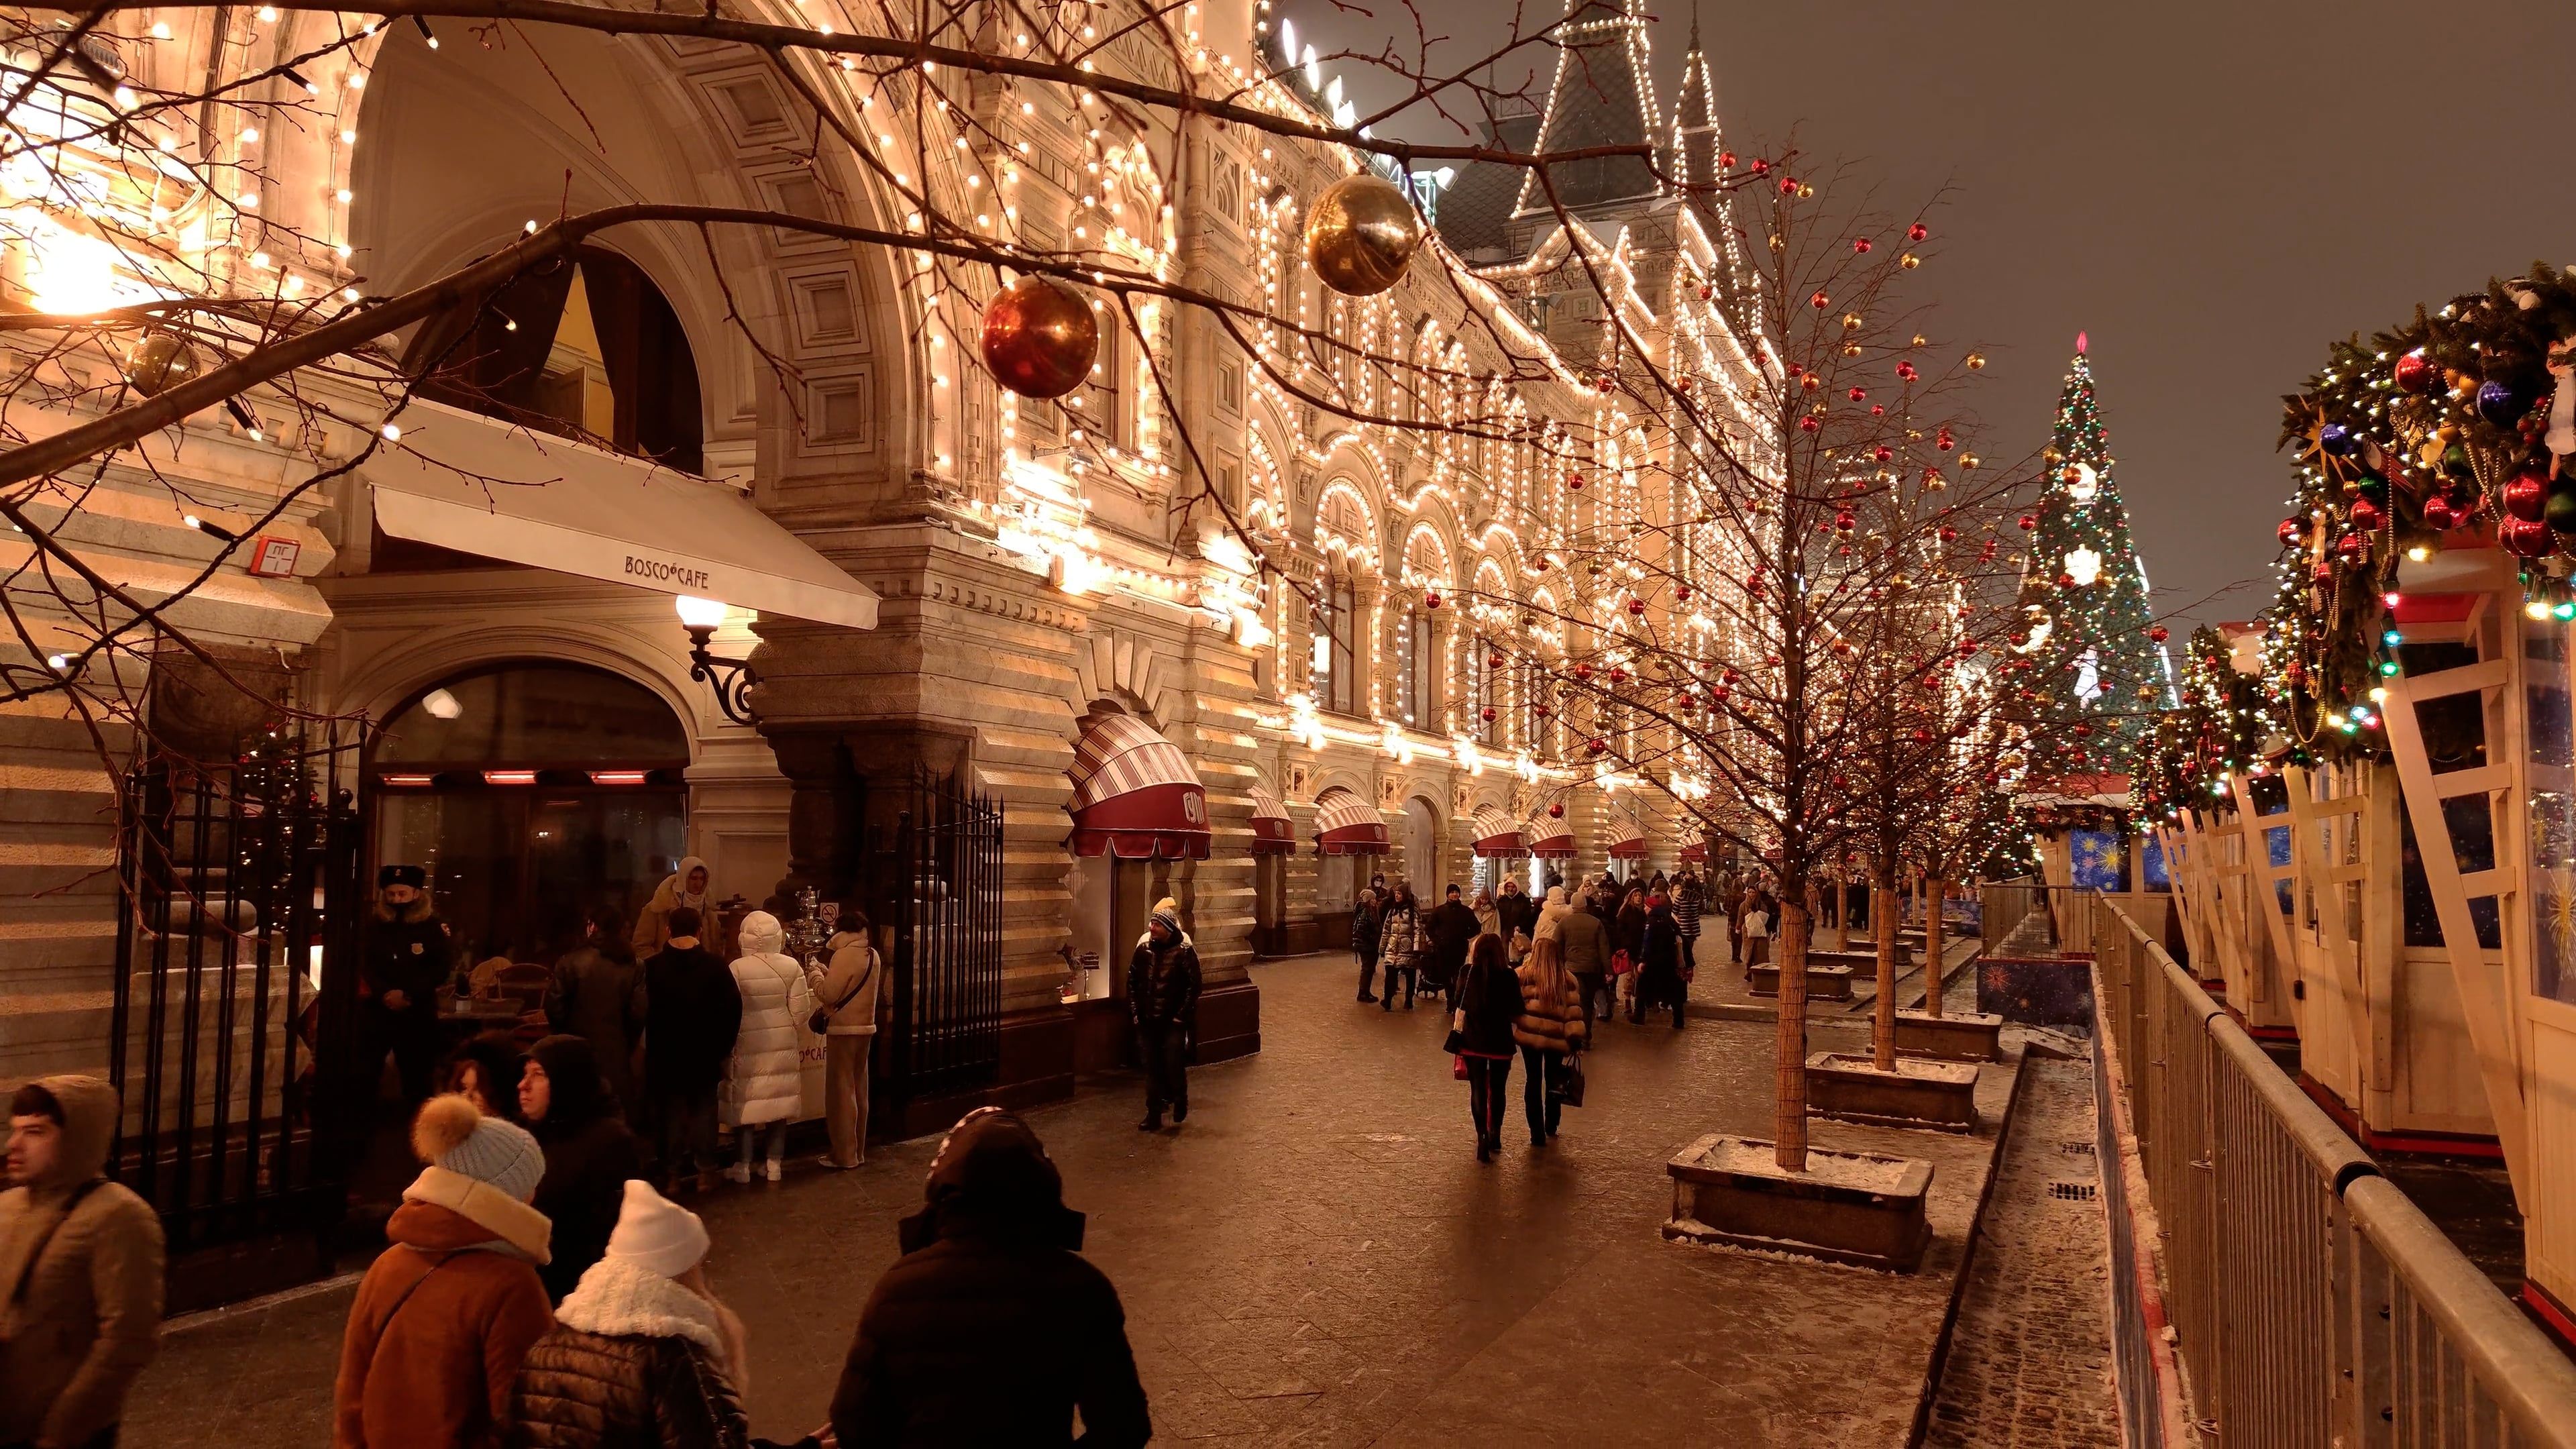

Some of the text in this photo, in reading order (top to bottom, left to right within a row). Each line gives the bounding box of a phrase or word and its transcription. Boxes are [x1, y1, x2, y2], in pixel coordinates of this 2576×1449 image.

[625, 555, 709, 589] BOSCO CAFE
[810, 1046, 826, 1061] CAF
